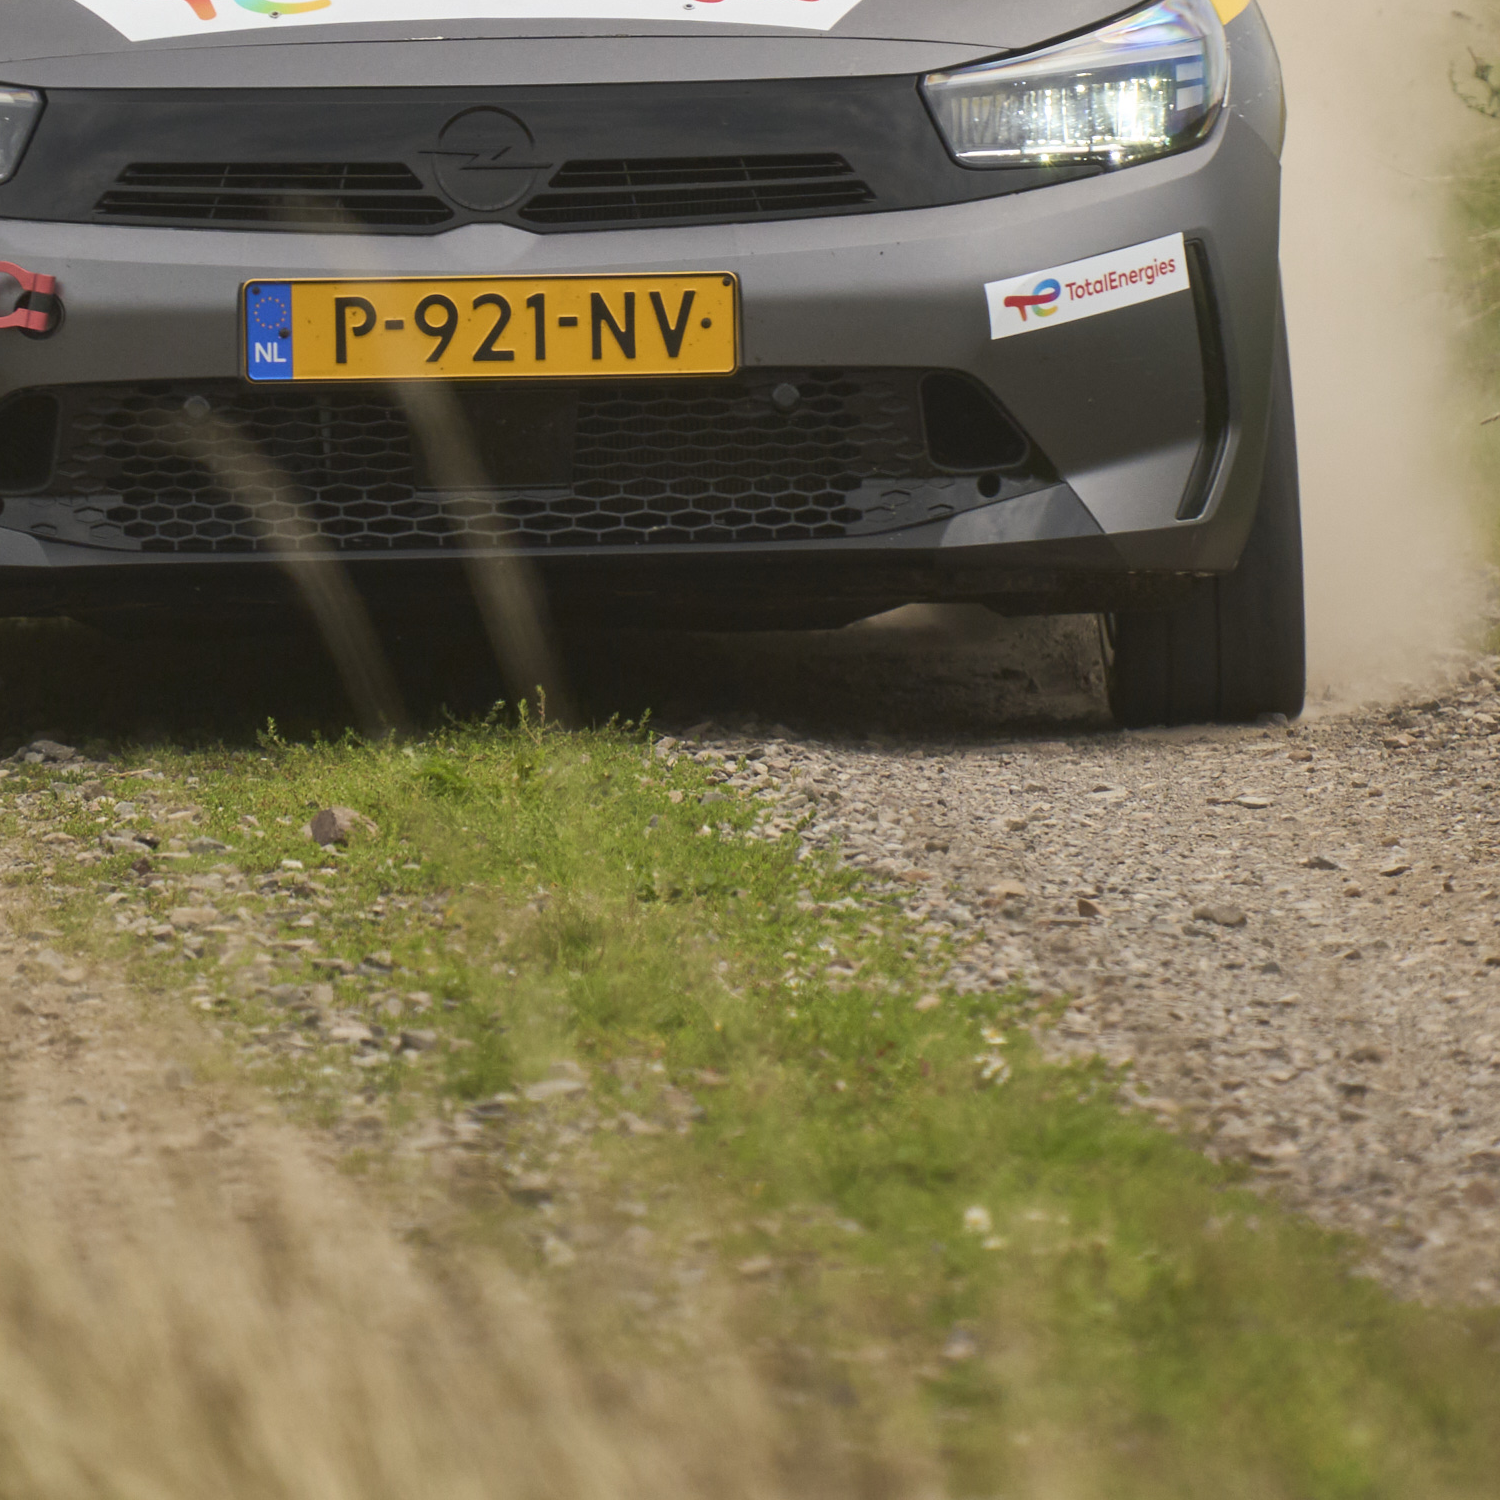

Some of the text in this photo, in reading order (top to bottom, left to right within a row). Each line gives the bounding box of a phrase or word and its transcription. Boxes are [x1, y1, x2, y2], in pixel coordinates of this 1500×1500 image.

[1065, 258, 1176, 301] TotalEnergies
[334, 290, 696, 364] P-921-NV
[254, 342, 287, 363] NL
